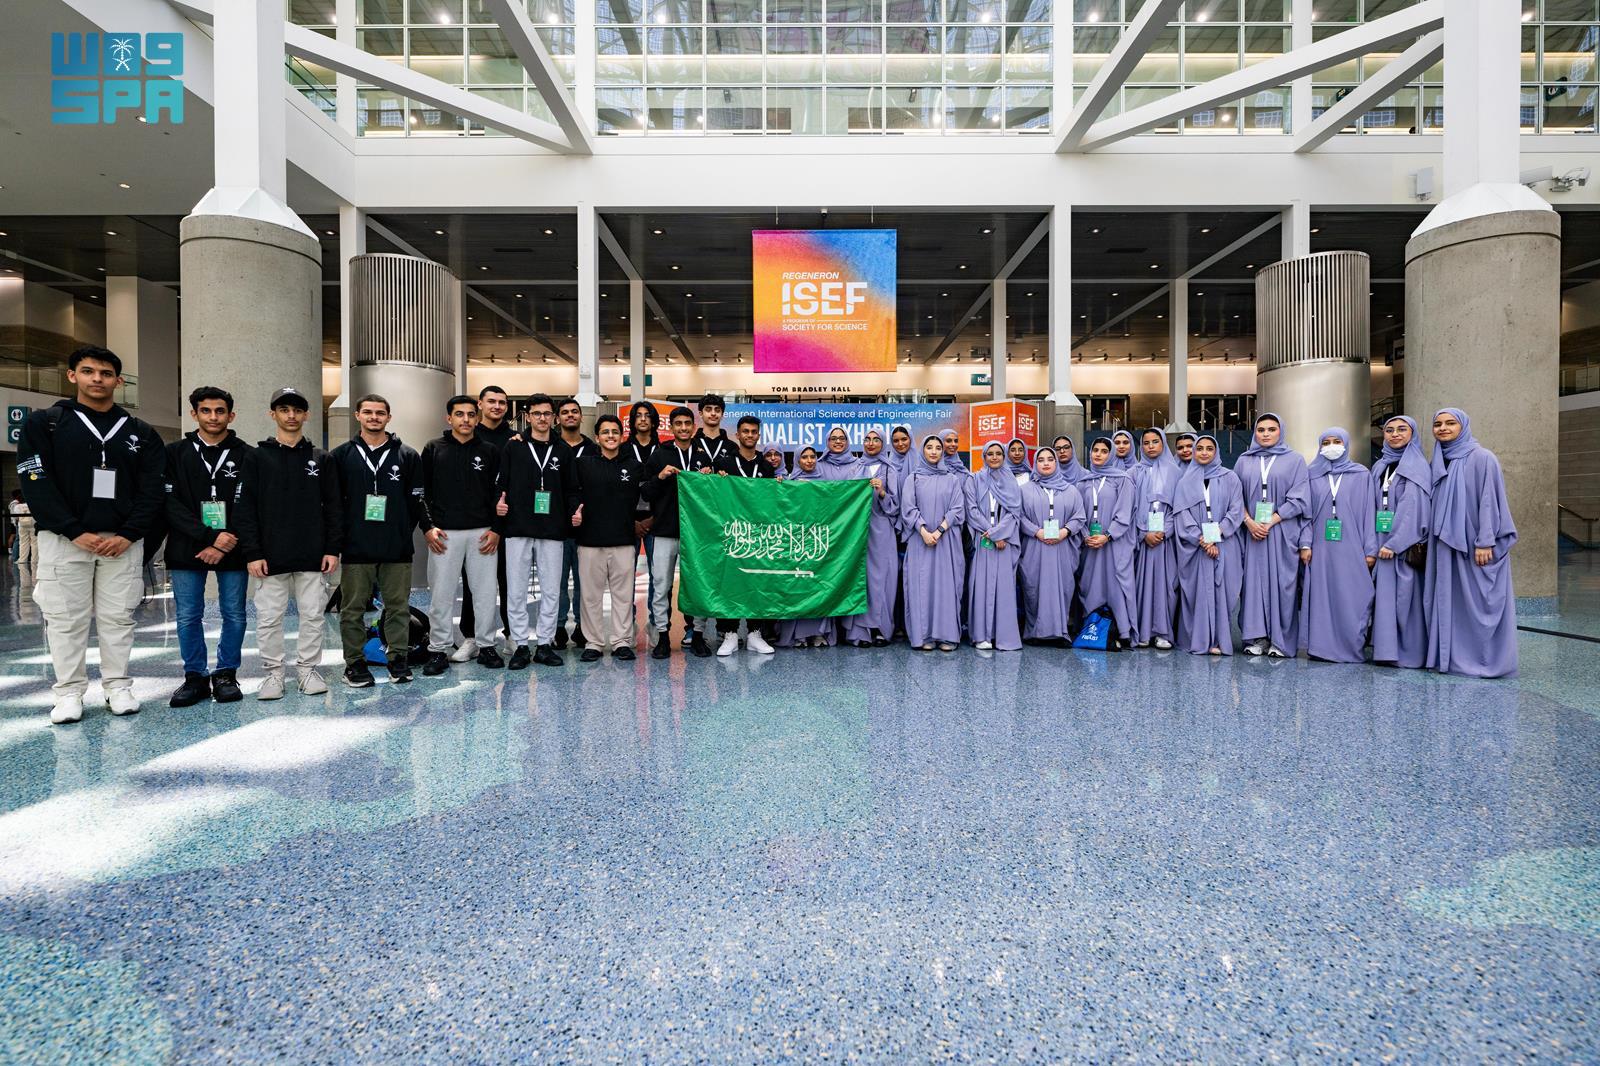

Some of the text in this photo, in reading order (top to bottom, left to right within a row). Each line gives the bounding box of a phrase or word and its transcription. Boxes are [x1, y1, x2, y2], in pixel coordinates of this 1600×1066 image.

[782, 272, 840, 280] REGENERON
[782, 281, 868, 316] ISEF
[782, 323, 868, 331] SOCIETY FOR SCIENCE
[758, 409, 816, 418] International
[818, 409, 857, 418] Science
[858, 409, 875, 418] and
[877, 409, 933, 419] Engineering
[935, 409, 952, 418] Fair
[978, 416, 1007, 431] ISEF
[1018, 417, 1035, 431] ISEF
[757, 422, 826, 445] NALIST
